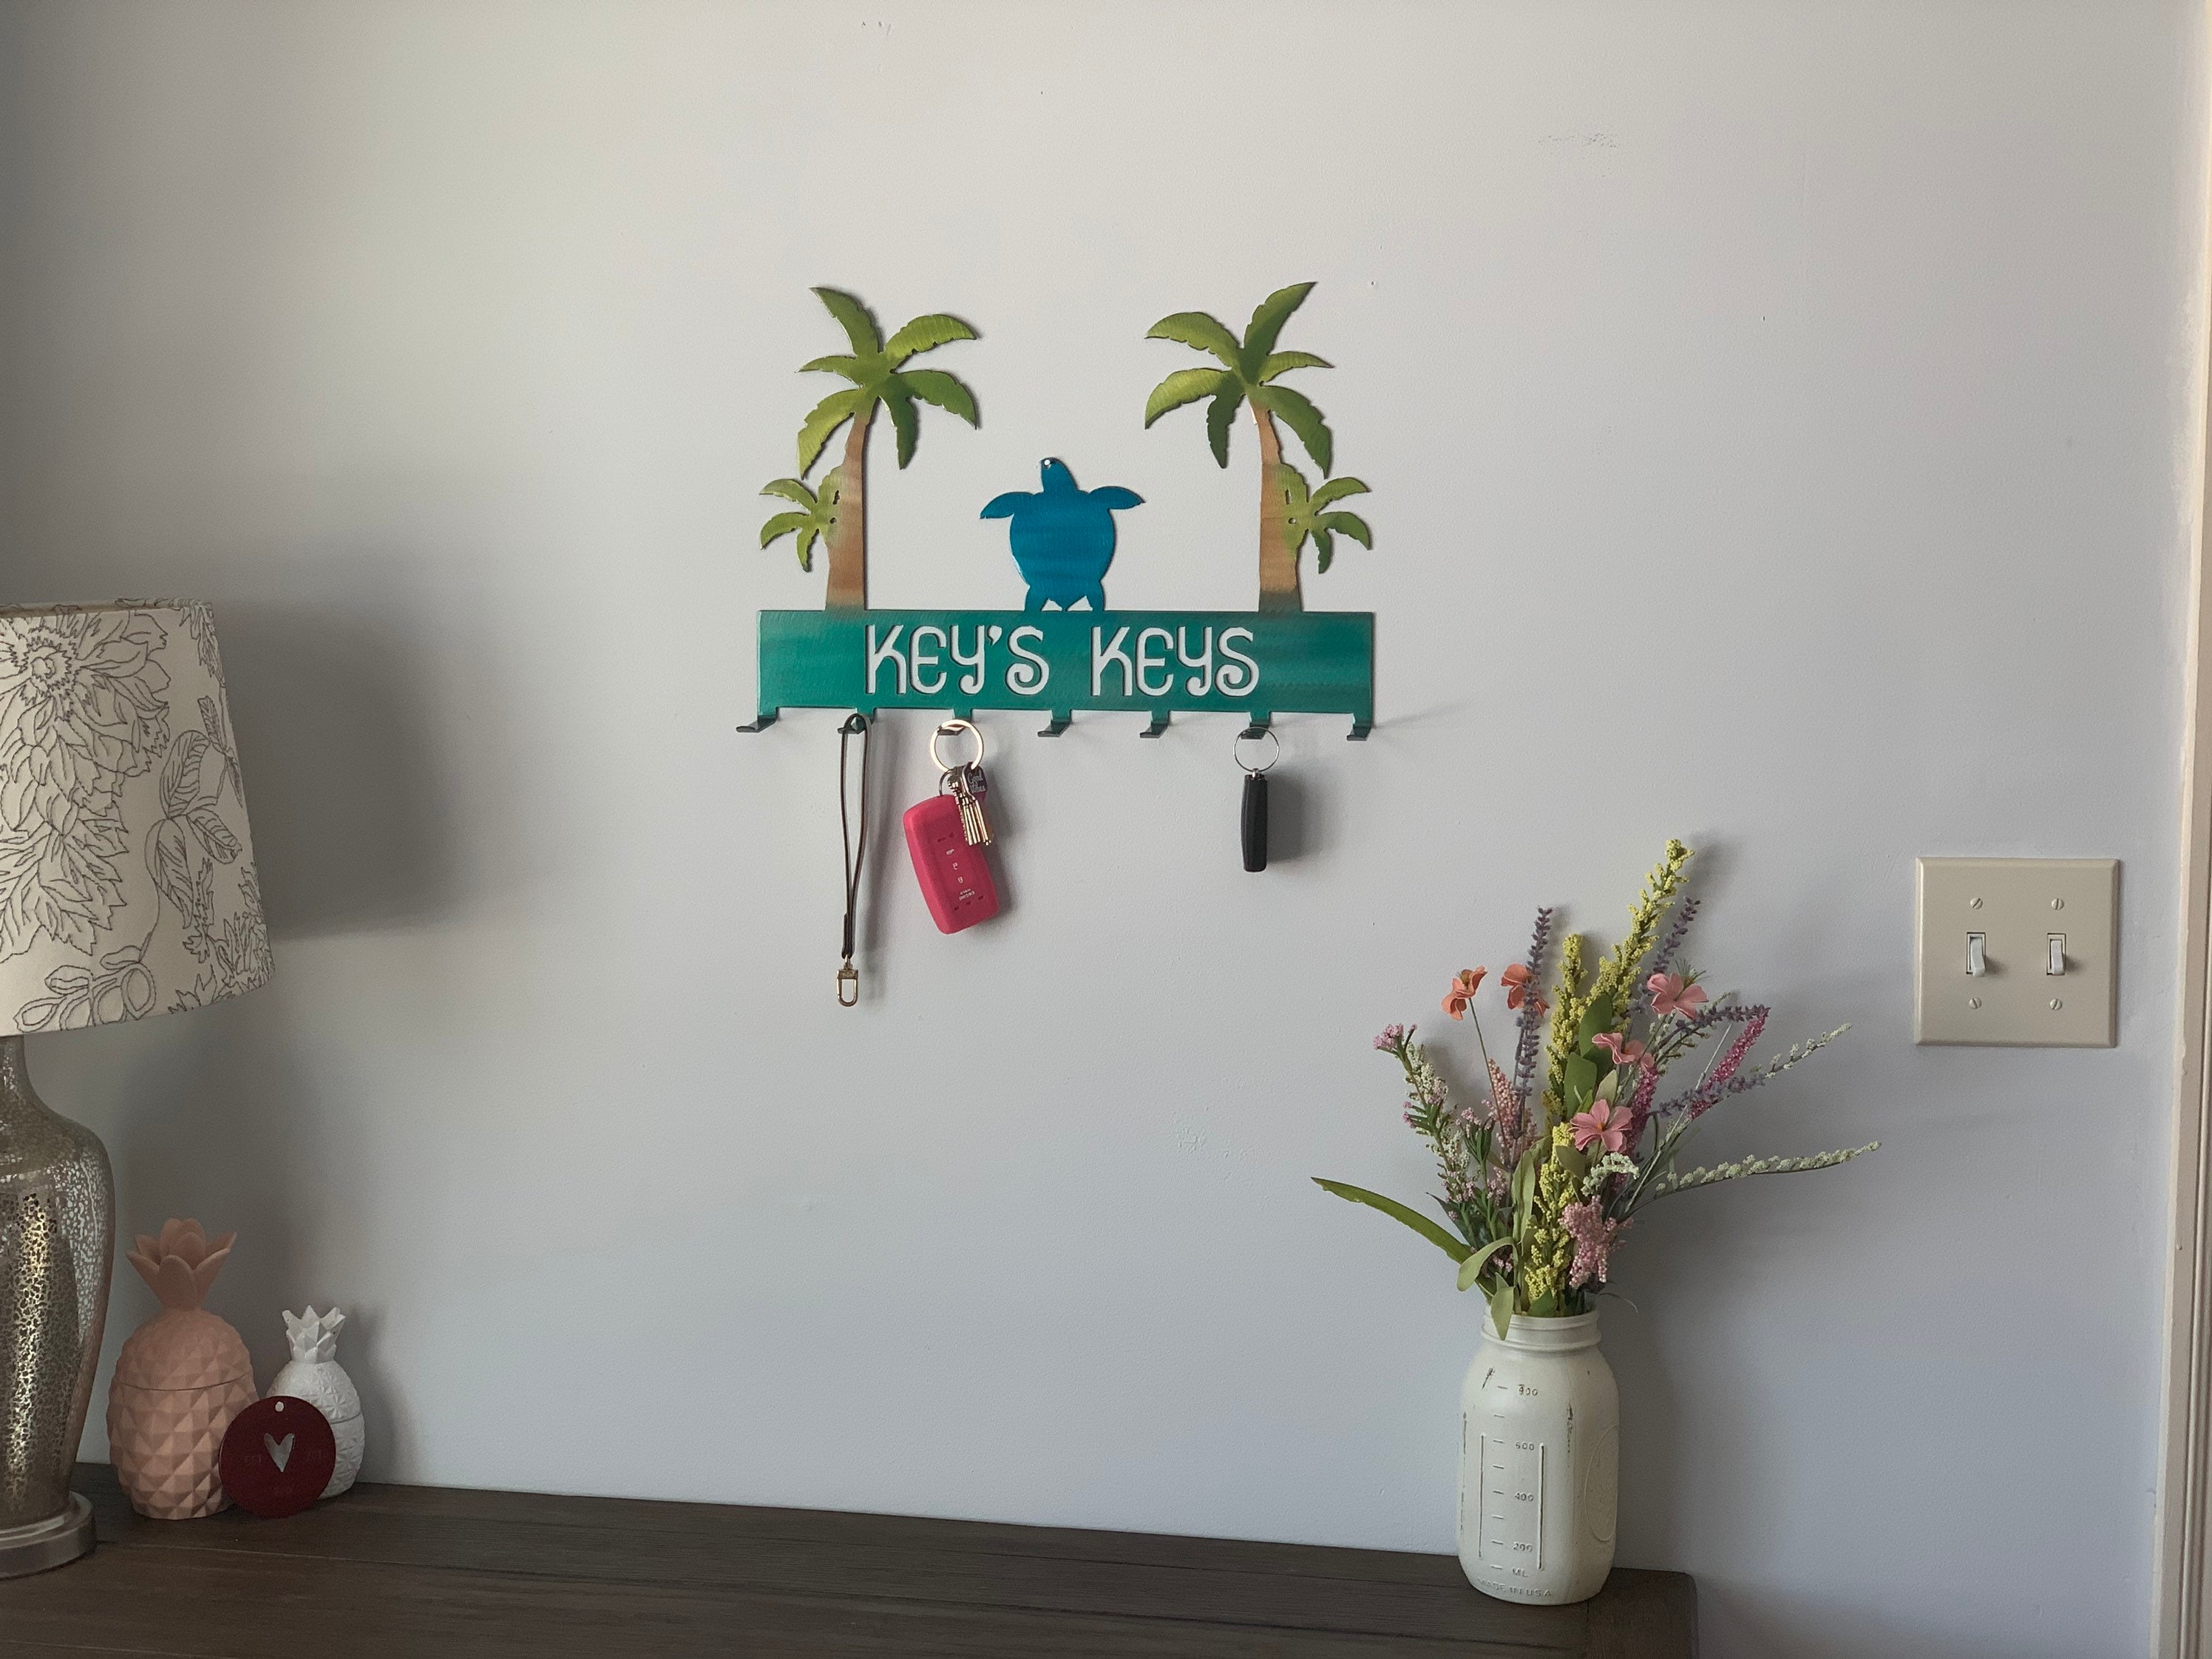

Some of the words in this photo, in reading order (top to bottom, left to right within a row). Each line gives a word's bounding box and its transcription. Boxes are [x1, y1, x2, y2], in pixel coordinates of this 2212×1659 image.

[864, 624, 1050, 695] KEY'S
[1090, 626, 1260, 696] KEYS
[1515, 1441, 1535, 1451] 600
[1514, 1493, 1534, 1502] 400
[1513, 1542, 1533, 1553] 200
[1512, 1568, 1529, 1578] ML
